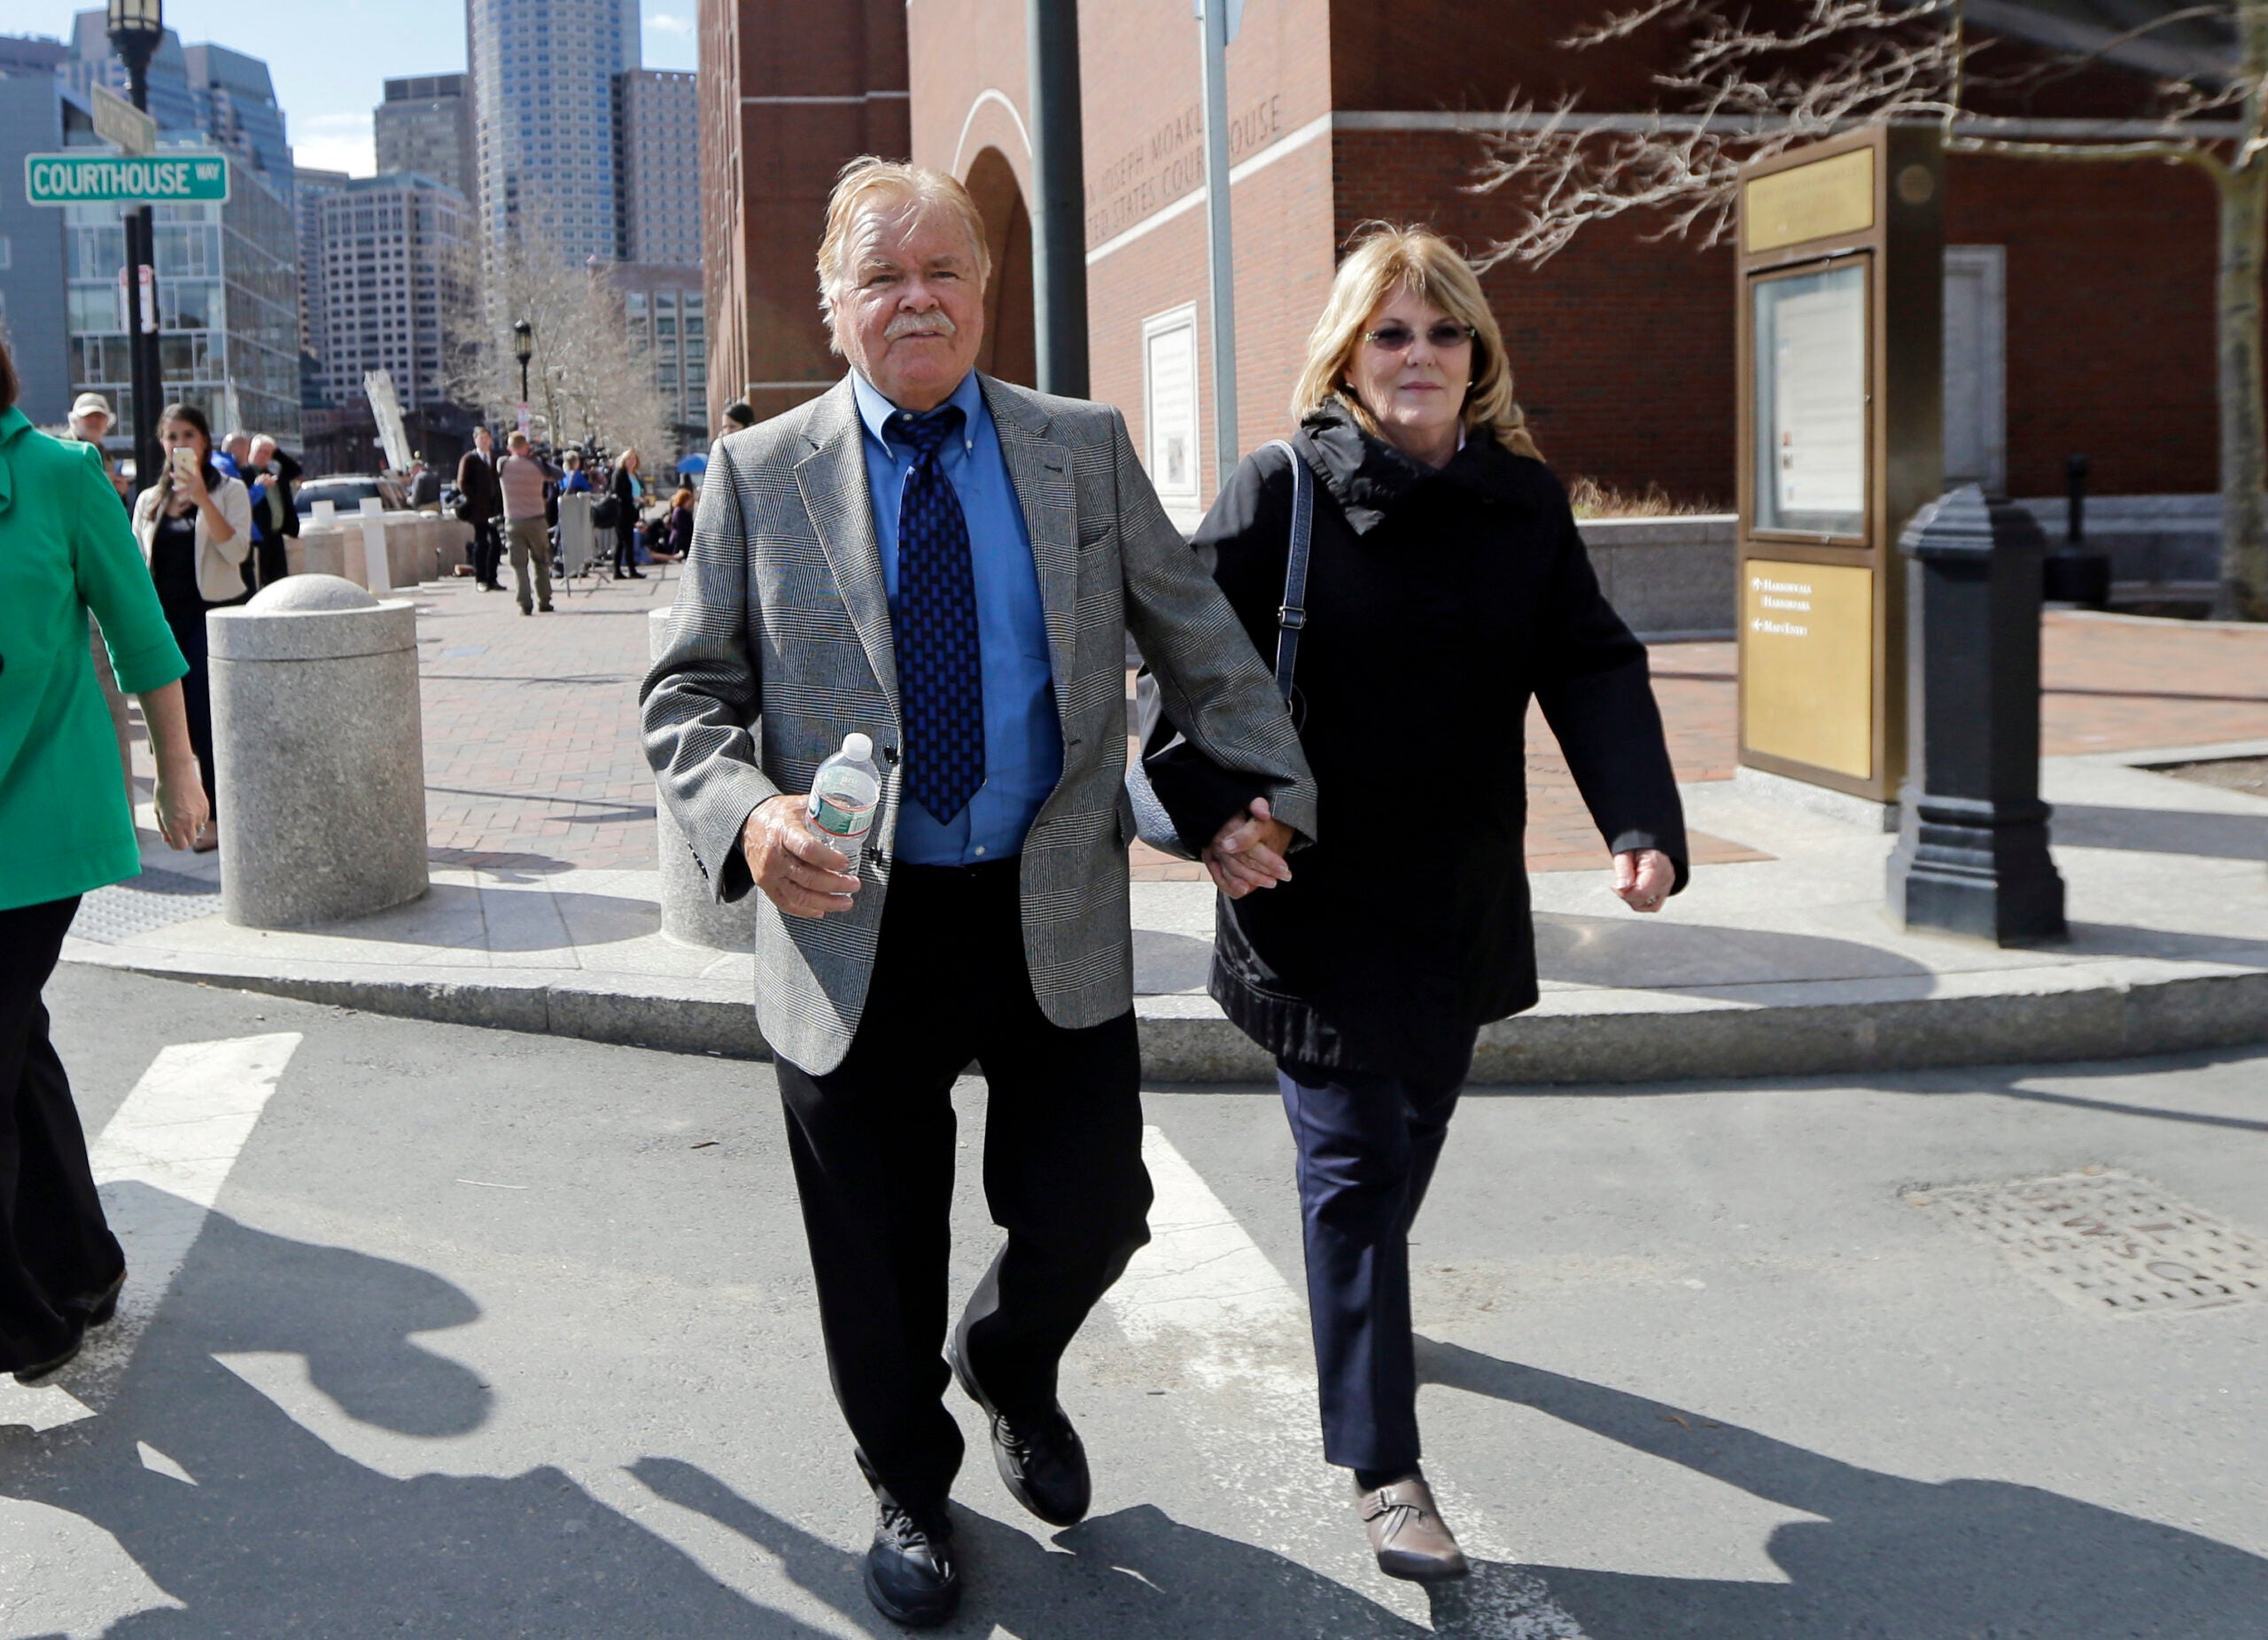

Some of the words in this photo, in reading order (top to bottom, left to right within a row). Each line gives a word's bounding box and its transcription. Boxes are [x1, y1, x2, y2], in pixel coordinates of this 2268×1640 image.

[1152, 103, 1202, 159] MOAKL
[34, 163, 190, 195] COURTHOUSE
[196, 163, 220, 180] WAY
[1114, 177, 1155, 225] STATES
